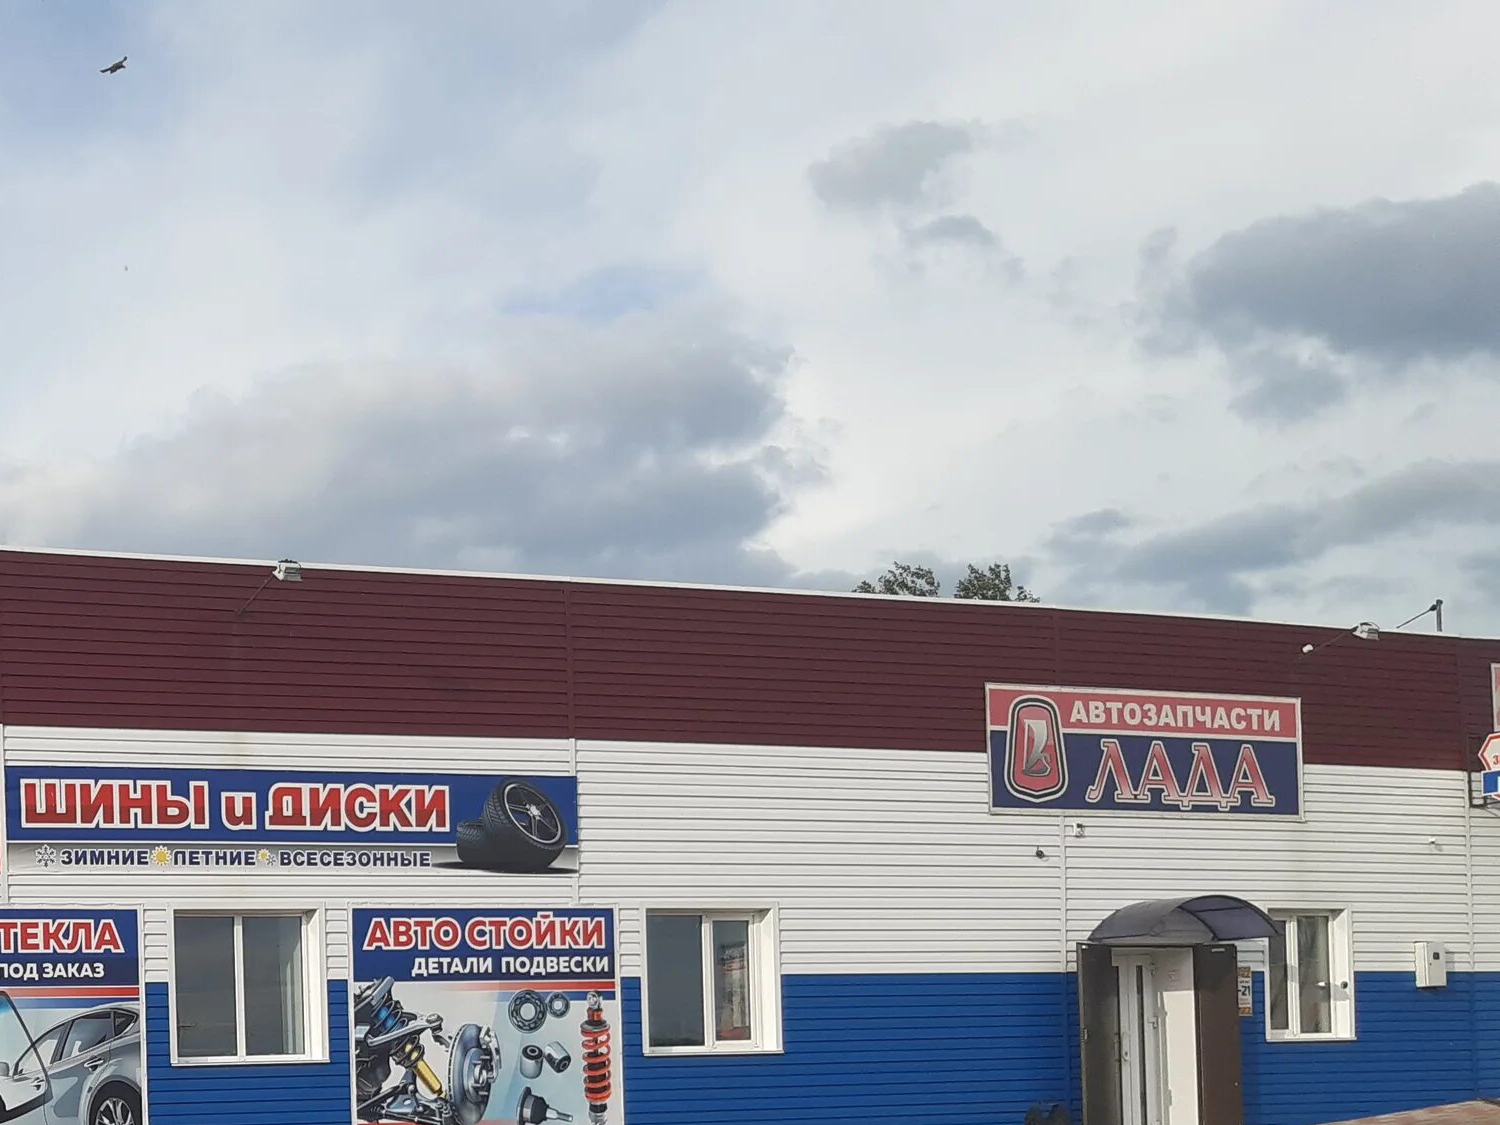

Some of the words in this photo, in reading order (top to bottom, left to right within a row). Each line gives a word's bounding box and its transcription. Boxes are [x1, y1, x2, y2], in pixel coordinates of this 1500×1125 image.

[1070, 700, 1280, 731] АВТОЗАПЧАСТИ
[1086, 738, 1275, 811] ЛАДА
[20, 778, 208, 830] ШИНЫ
[221, 791, 257, 830] и
[265, 781, 450, 832] ДИСКИ
[60, 848, 149, 867] ЗИМНИЕ
[173, 848, 257, 867] ЛЕТНИЕ
[278, 849, 431, 868] ВСЕСЕЗОННЫЕ
[363, 916, 460, 950] АВТО
[466, 912, 606, 950] СТОЙКИ
[42, 962, 104, 979] ЗАКАЗ
[411, 957, 493, 977] ДЕТАЛИ
[500, 956, 609, 977] ПОДВЕСКИ
